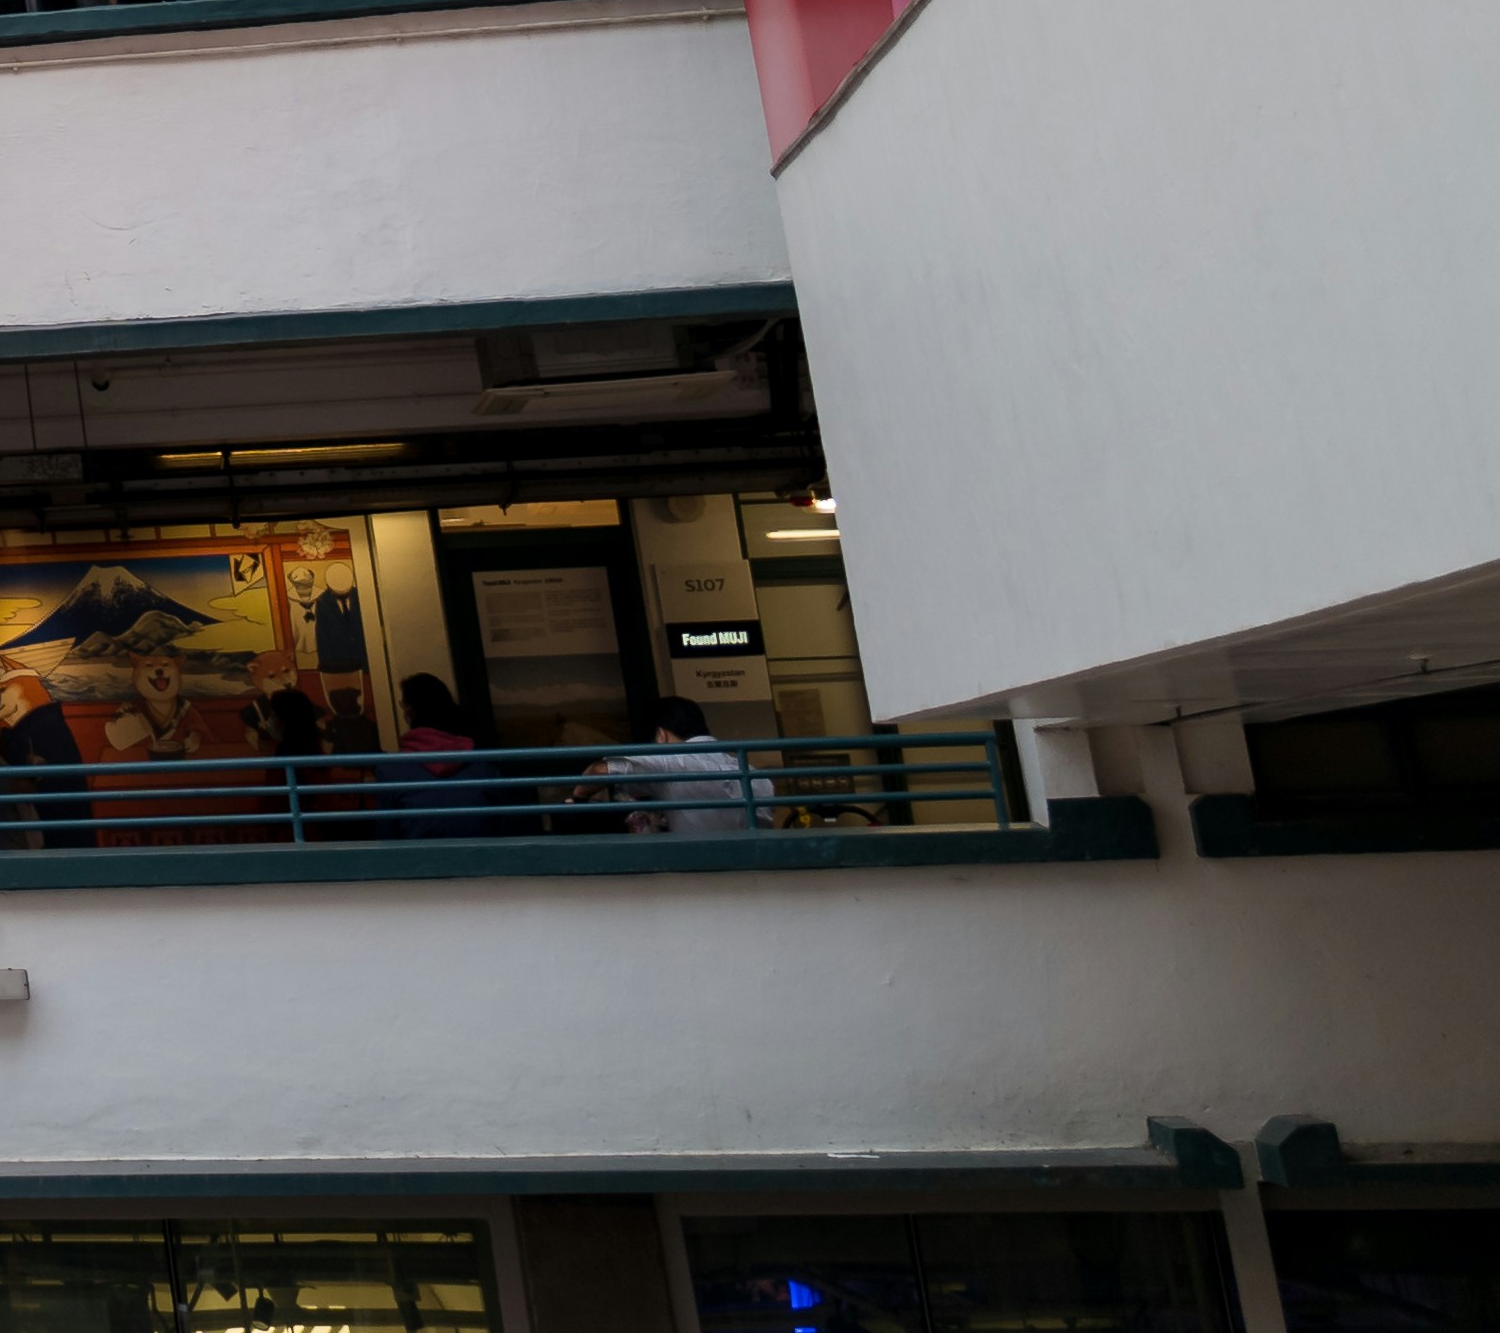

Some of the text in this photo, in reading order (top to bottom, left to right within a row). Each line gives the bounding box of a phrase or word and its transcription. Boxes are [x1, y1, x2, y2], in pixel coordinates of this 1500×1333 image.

[684, 578, 725, 593] S107
[681, 631, 749, 647] Found MUJI
